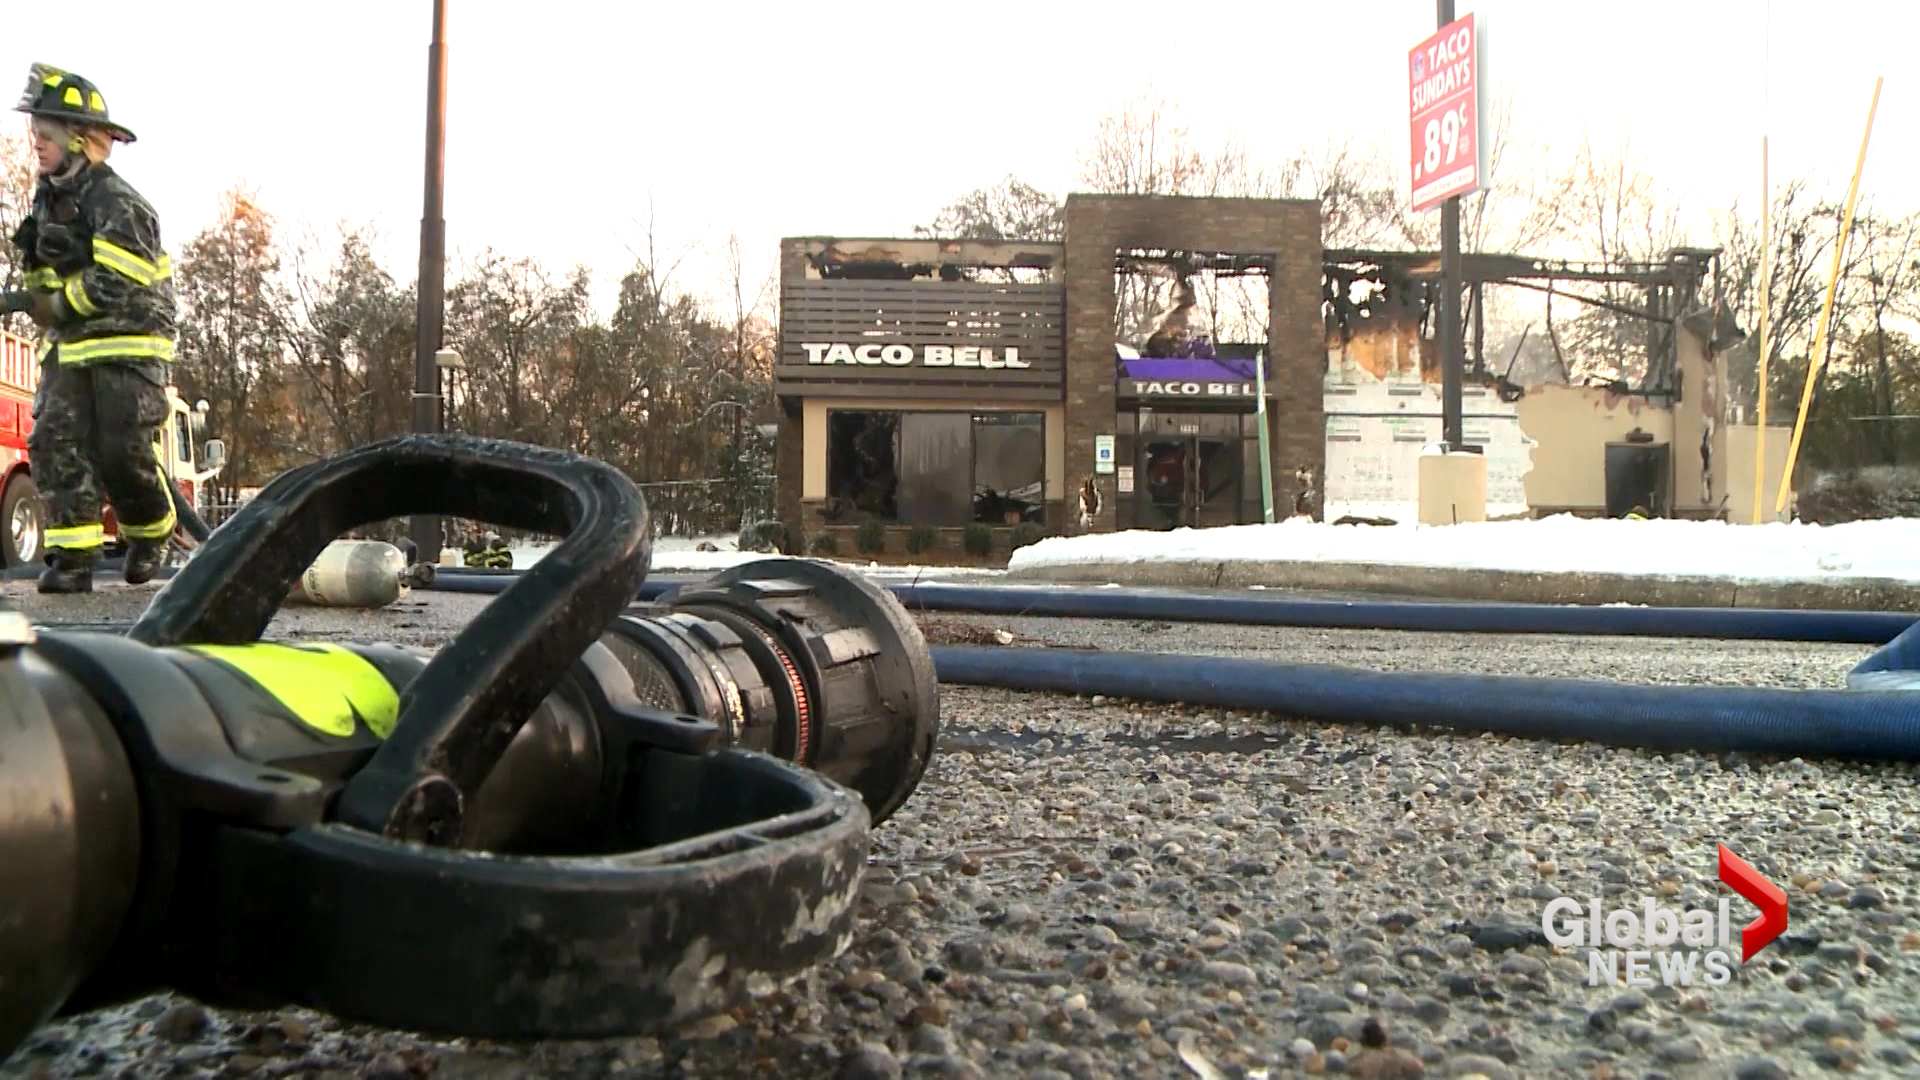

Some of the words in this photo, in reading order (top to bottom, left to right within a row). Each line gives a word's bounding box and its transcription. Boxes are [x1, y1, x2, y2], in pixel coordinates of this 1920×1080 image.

[1427, 27, 1470, 72] TACO
[1412, 56, 1471, 112] SUNDAYS
[801, 343, 913, 365] TACO
[924, 346, 1031, 368] BELL
[1132, 381, 1200, 395] TACO
